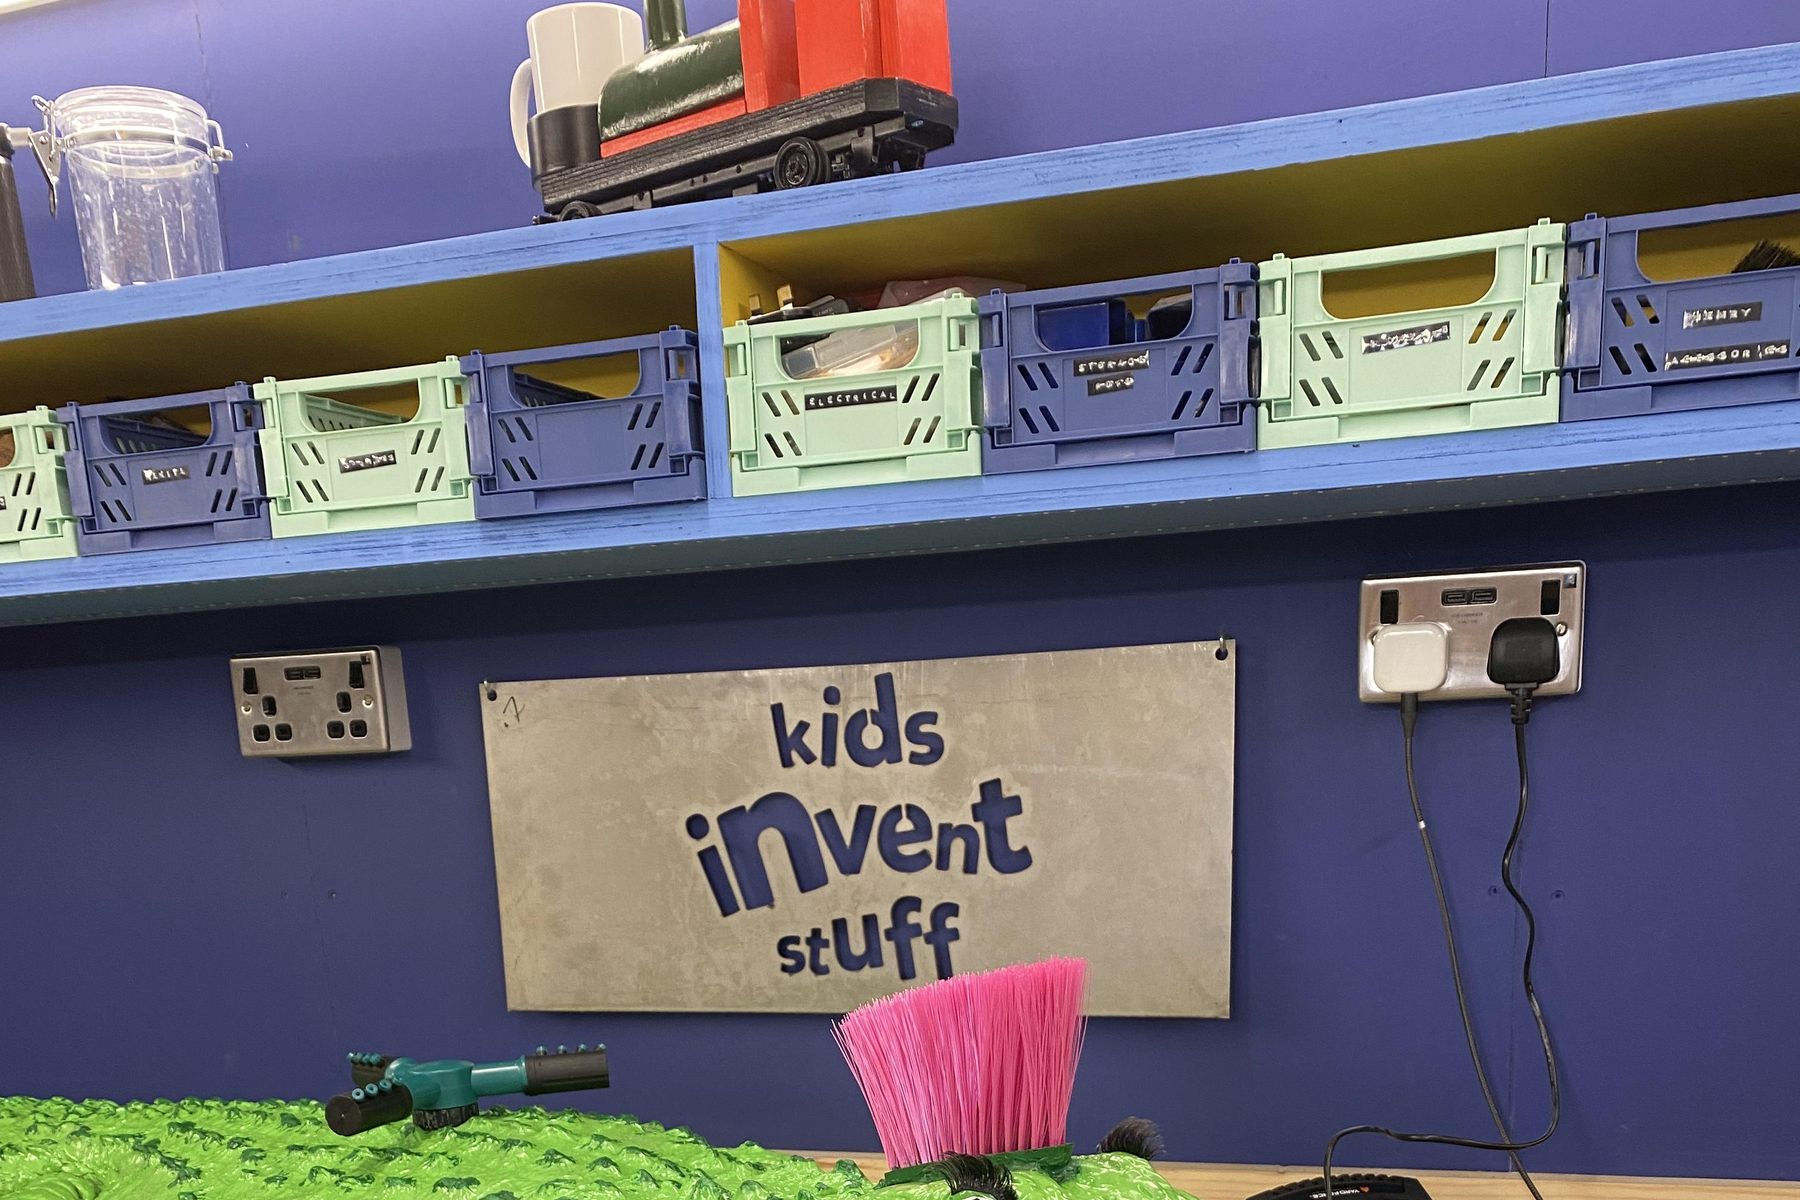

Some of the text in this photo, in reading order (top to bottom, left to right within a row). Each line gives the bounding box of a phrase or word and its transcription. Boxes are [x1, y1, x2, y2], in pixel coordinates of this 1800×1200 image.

[809, 390, 896, 406] ELECTRICAL
[771, 672, 945, 768] kids
[686, 778, 1033, 918] invent
[777, 896, 960, 981] stuff
